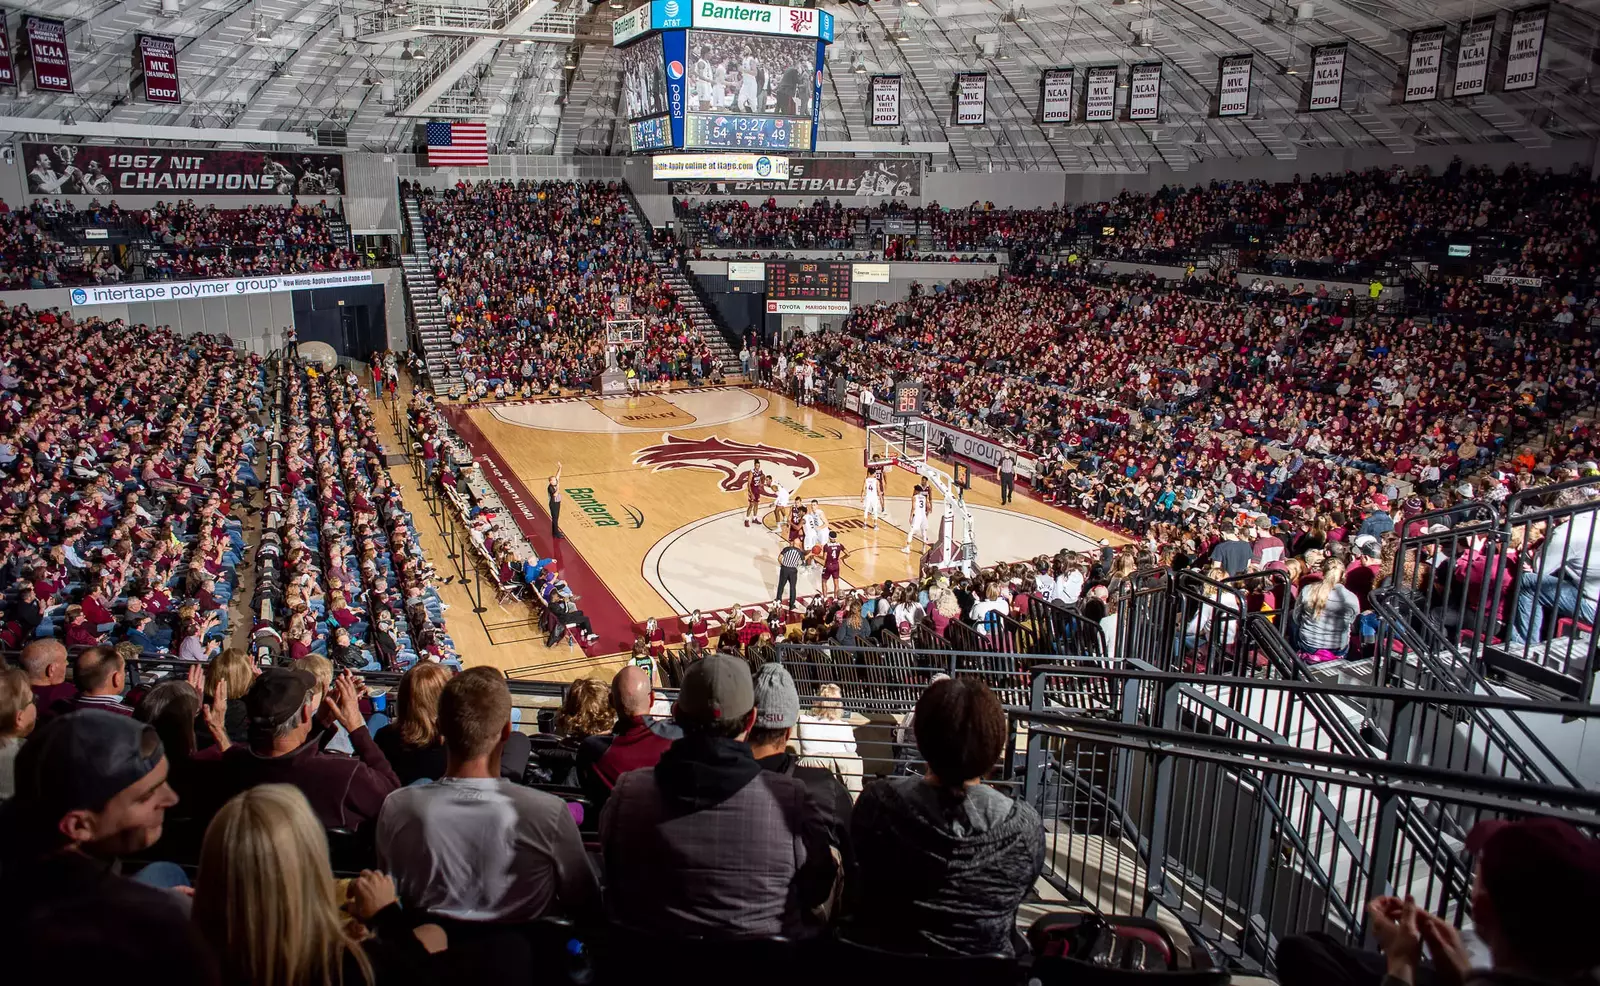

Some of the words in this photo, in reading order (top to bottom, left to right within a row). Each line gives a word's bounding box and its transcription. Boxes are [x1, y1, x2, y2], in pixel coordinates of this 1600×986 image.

[701, 2, 771, 22] Banterra
[790, 10, 812, 23] SIU
[614, 16, 635, 35] Banterra
[663, 19, 681, 27] AT&T
[1516, 38, 1535, 51] MVC
[35, 44, 63, 57] NCAA
[1462, 47, 1485, 60] NCAA
[1509, 50, 1538, 61] CHAMPIONS
[150, 61, 170, 71] MVC
[1416, 56, 1434, 67] MVC
[147, 71, 176, 79] CHAMPIONS
[1317, 69, 1339, 79] NCAA
[1409, 67, 1438, 76] CHAMPIONS
[40, 75, 68, 86] 1992
[1227, 78, 1243, 87] MVC
[1507, 72, 1534, 84] 2003
[1135, 85, 1156, 93] NCAA
[1456, 80, 1482, 90] 2003
[149, 88, 177, 97] 2007
[1047, 89, 1068, 97] NCAA
[1093, 87, 1108, 95] MVC
[1407, 86, 1434, 95] 2004
[670, 84, 683, 119] pepsi
[1312, 96, 1338, 105] 2004
[1221, 103, 1245, 111] 2005
[732, 118, 767, 131] 13:27
[713, 127, 727, 138] 54
[772, 129, 786, 141] 49
[108, 154, 162, 168] 1967
[169, 156, 204, 170] NIT
[669, 162, 684, 170] Apply
[685, 162, 706, 170] online
[120, 172, 275, 190] CHAMPIONS
[312, 277, 326, 285] Apply
[790, 276, 799, 284] 54
[93, 288, 166, 301] intertape
[171, 282, 229, 299] polymer
[564, 487, 620, 527] Banterra
[919, 500, 924, 508] 3
[766, 713, 784, 722] SIU
